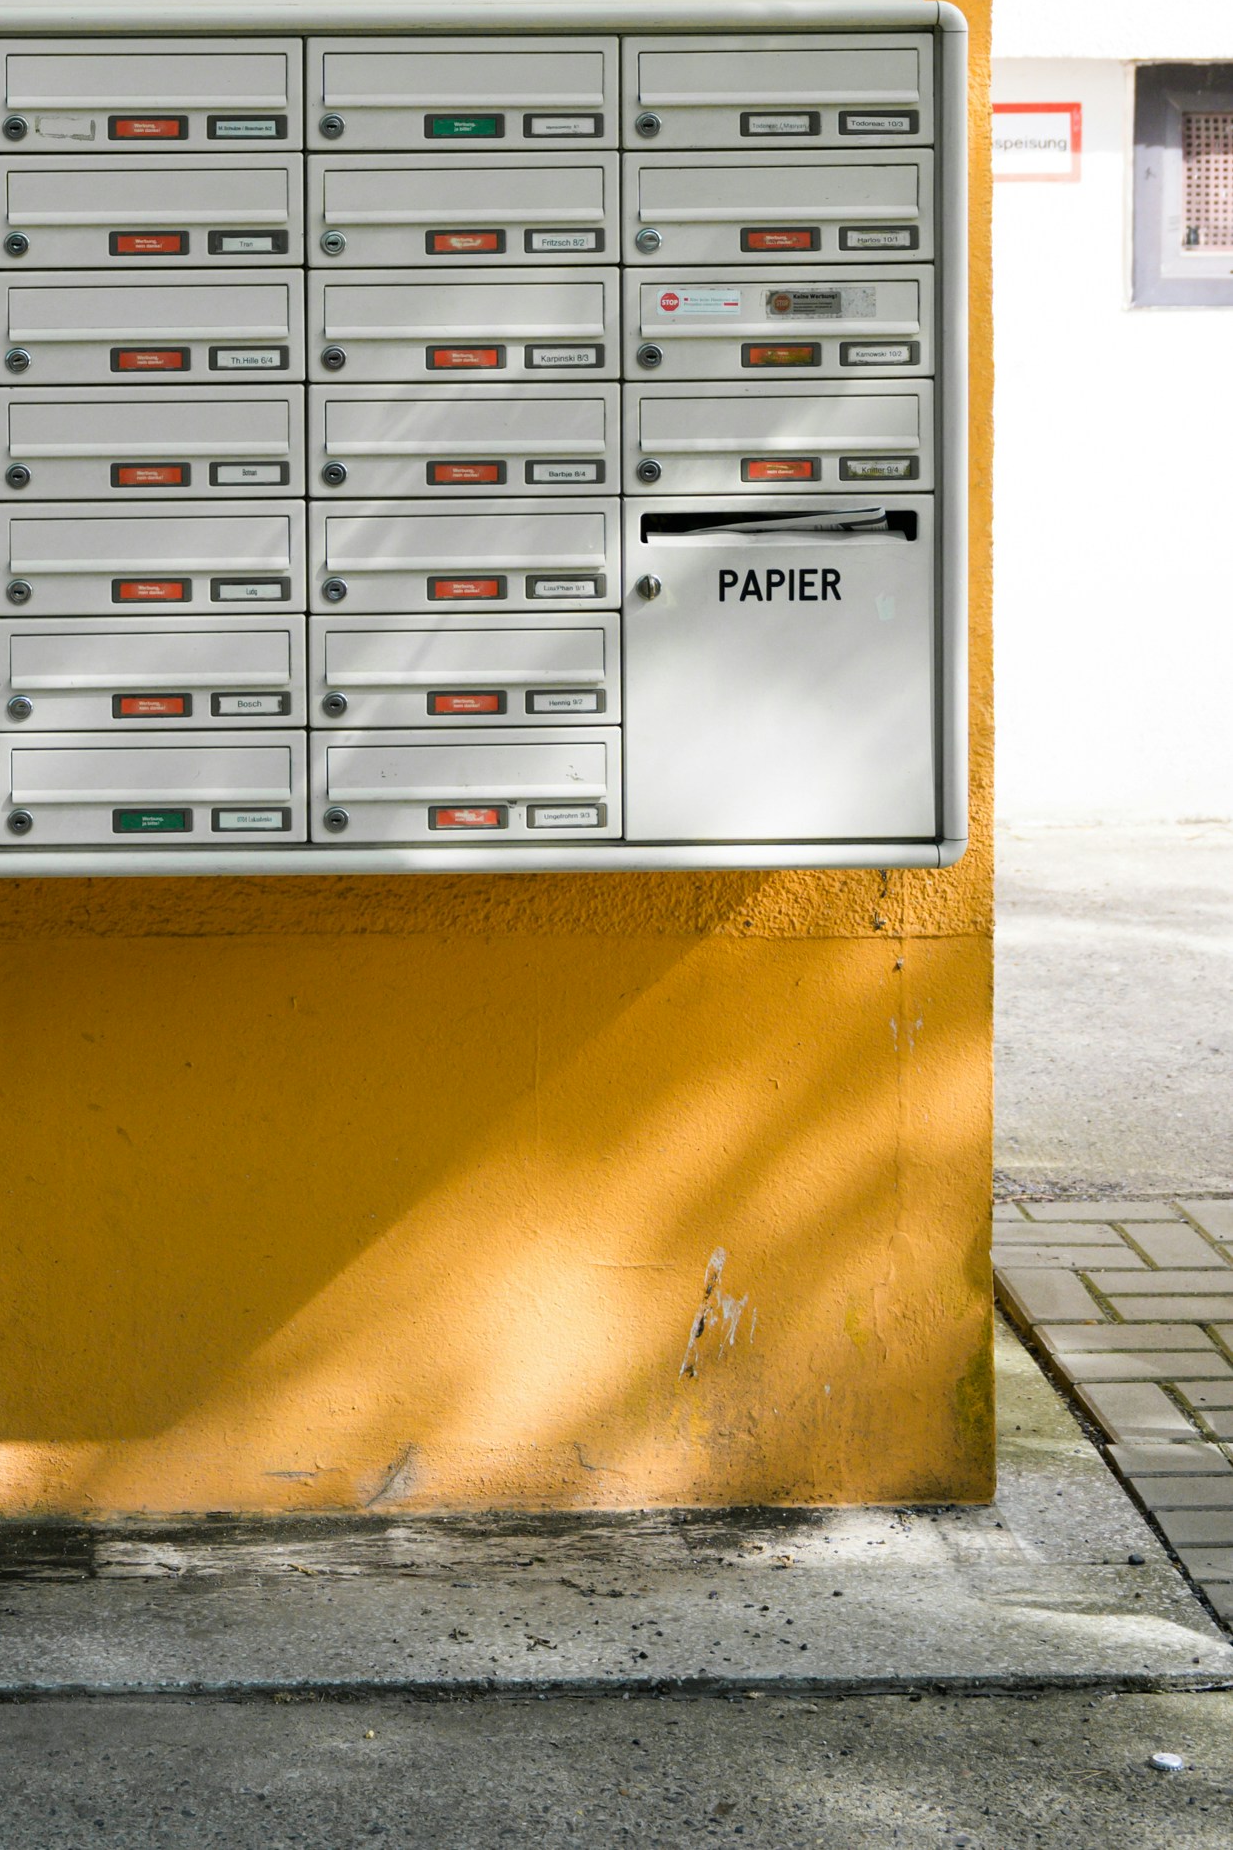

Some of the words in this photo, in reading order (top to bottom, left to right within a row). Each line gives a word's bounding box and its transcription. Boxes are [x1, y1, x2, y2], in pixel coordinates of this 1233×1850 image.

[992, 138, 1067, 152] speisung
[542, 239, 570, 247] Fritzsch
[541, 354, 574, 362] Karpinski
[577, 354, 589, 362] 8/3
[719, 568, 842, 602] PAPIER
[237, 700, 262, 708] Bosch
[549, 699, 570, 707] Hennig
